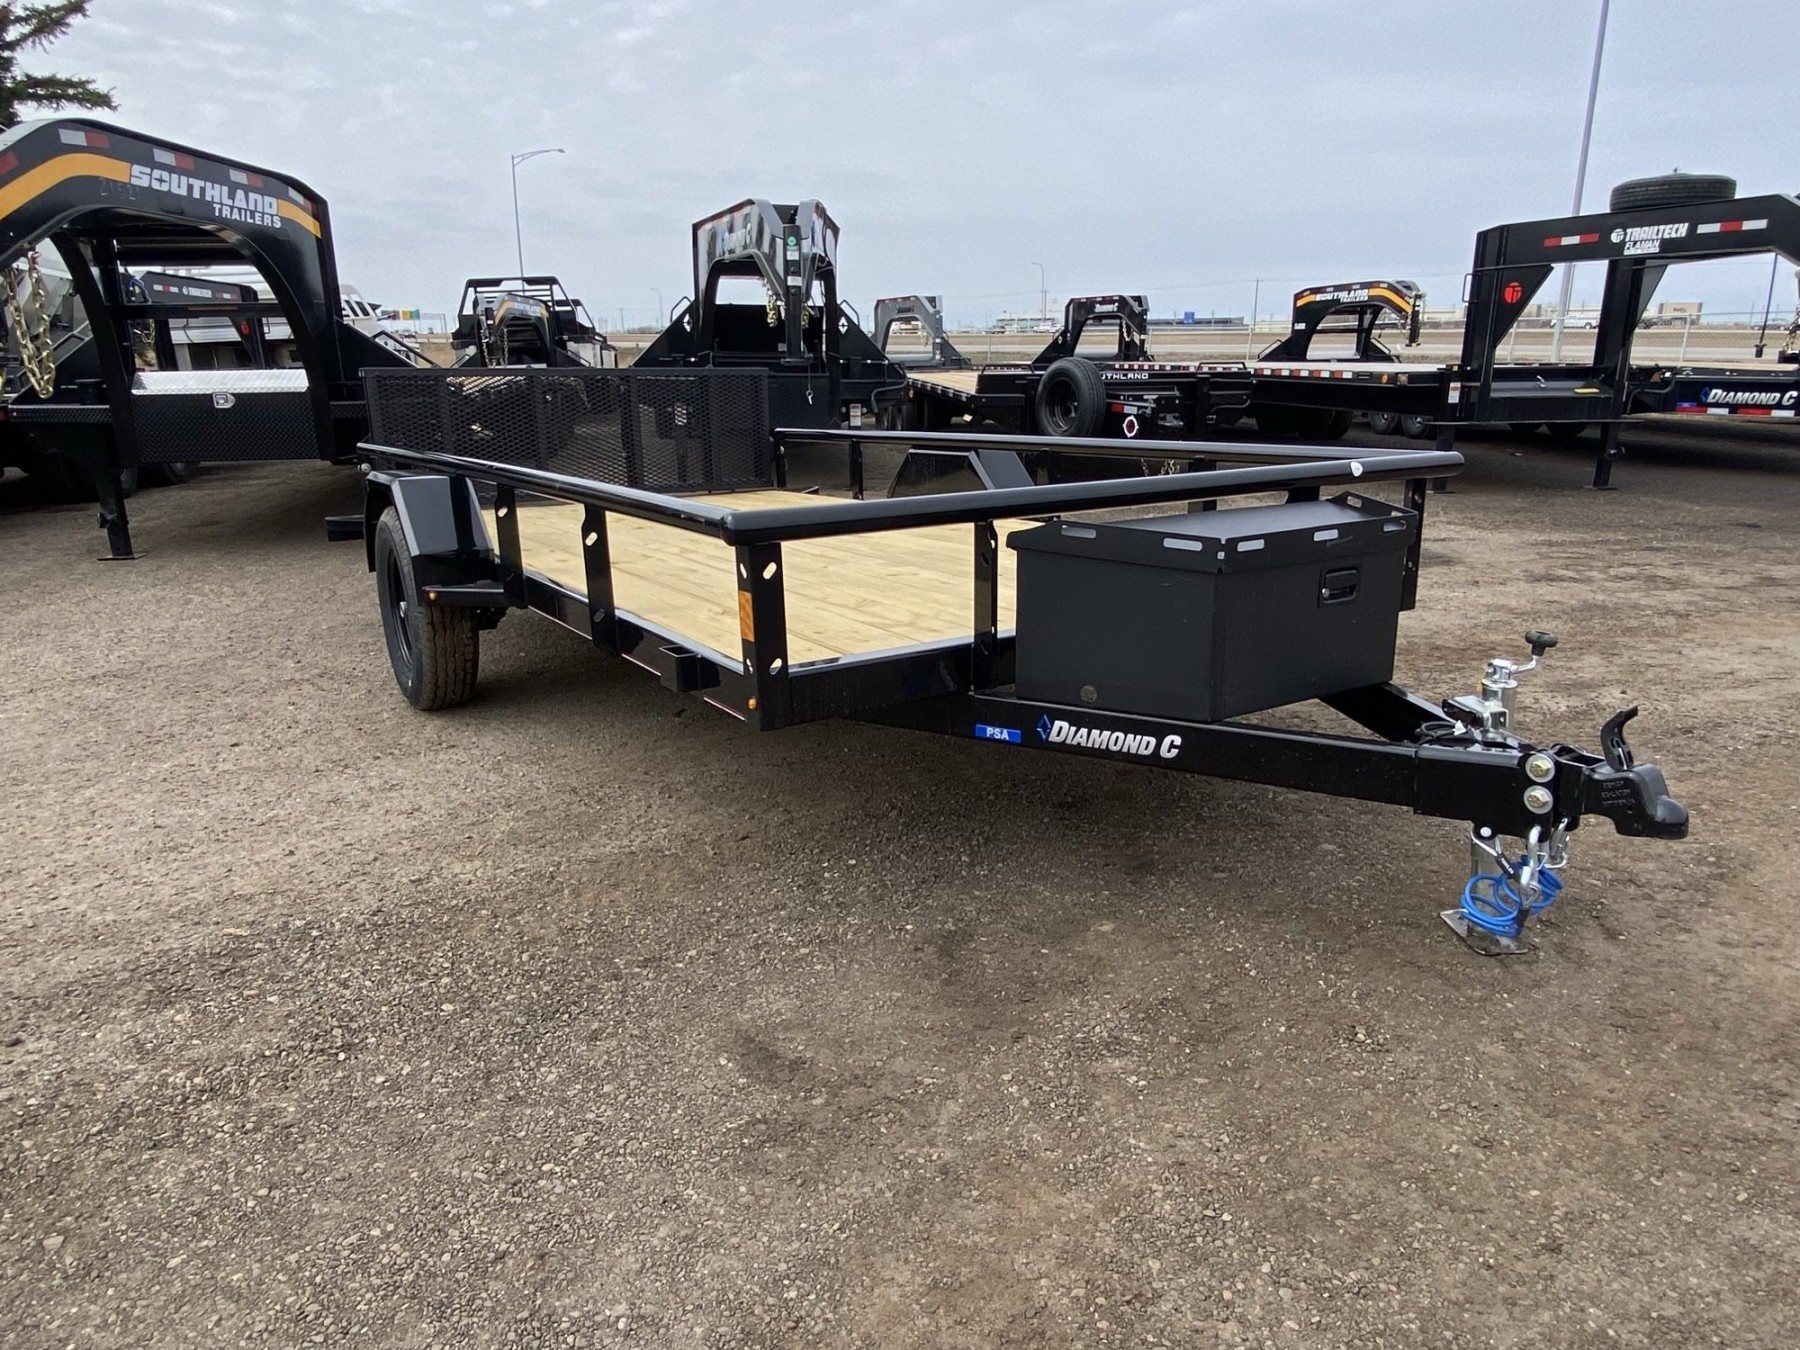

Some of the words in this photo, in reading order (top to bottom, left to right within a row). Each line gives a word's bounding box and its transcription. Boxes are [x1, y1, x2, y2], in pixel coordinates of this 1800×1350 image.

[131, 164, 278, 215] SOUTHLAND
[213, 203, 281, 228] TRAILERS
[1624, 222, 1689, 241] TRAILTECH
[1315, 288, 1369, 301] SOUTHLAND
[1101, 372, 1149, 380] UTHLAND
[1706, 388, 1781, 405] DIAMOND
[1781, 391, 1798, 406] C
[986, 726, 1010, 741] PSA
[1048, 719, 1157, 756] DIAMOND
[1159, 734, 1182, 759] C
